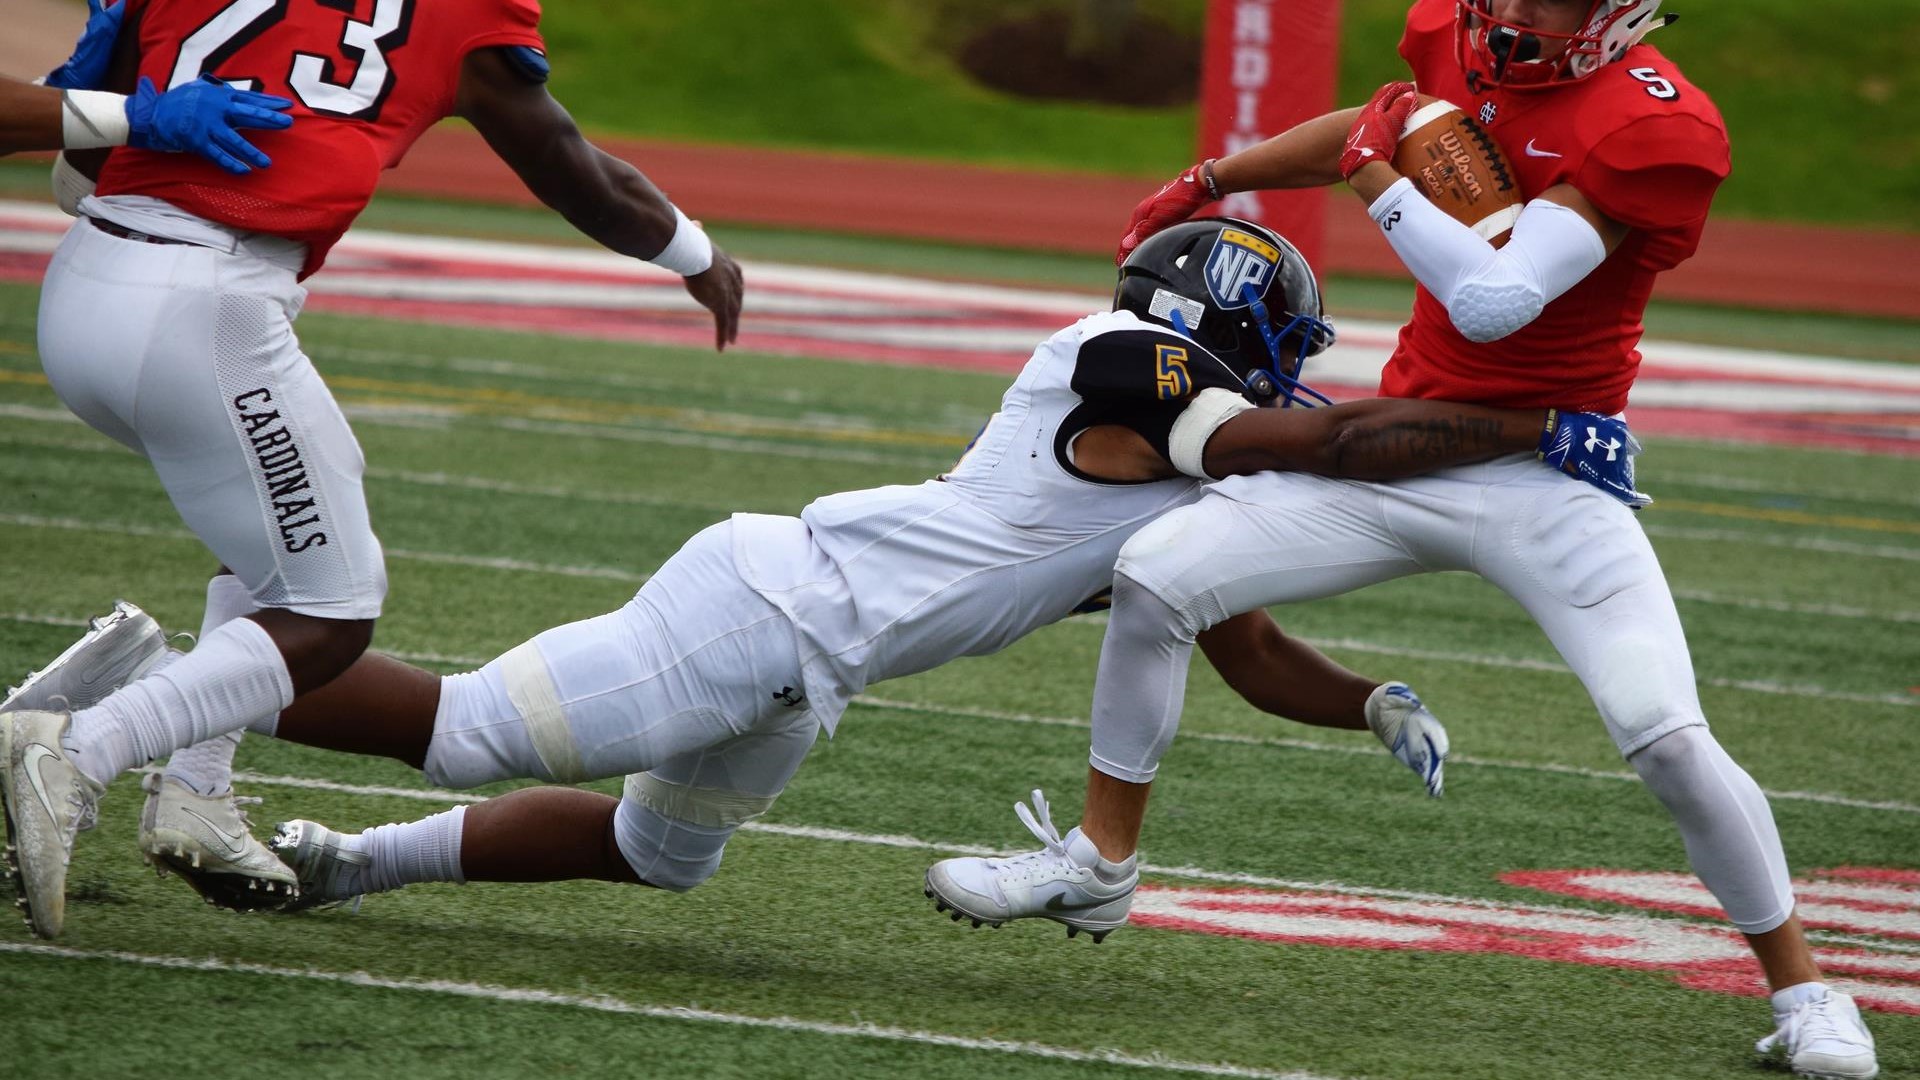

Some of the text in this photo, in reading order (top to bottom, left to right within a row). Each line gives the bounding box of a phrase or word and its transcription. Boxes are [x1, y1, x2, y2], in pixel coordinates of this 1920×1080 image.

[1628, 67, 1680, 101] 5
[1421, 166, 1444, 198] NCAA
[1440, 130, 1482, 199] Wilson
[1155, 344, 1192, 400] 5
[233, 387, 327, 554] CARDINALS
